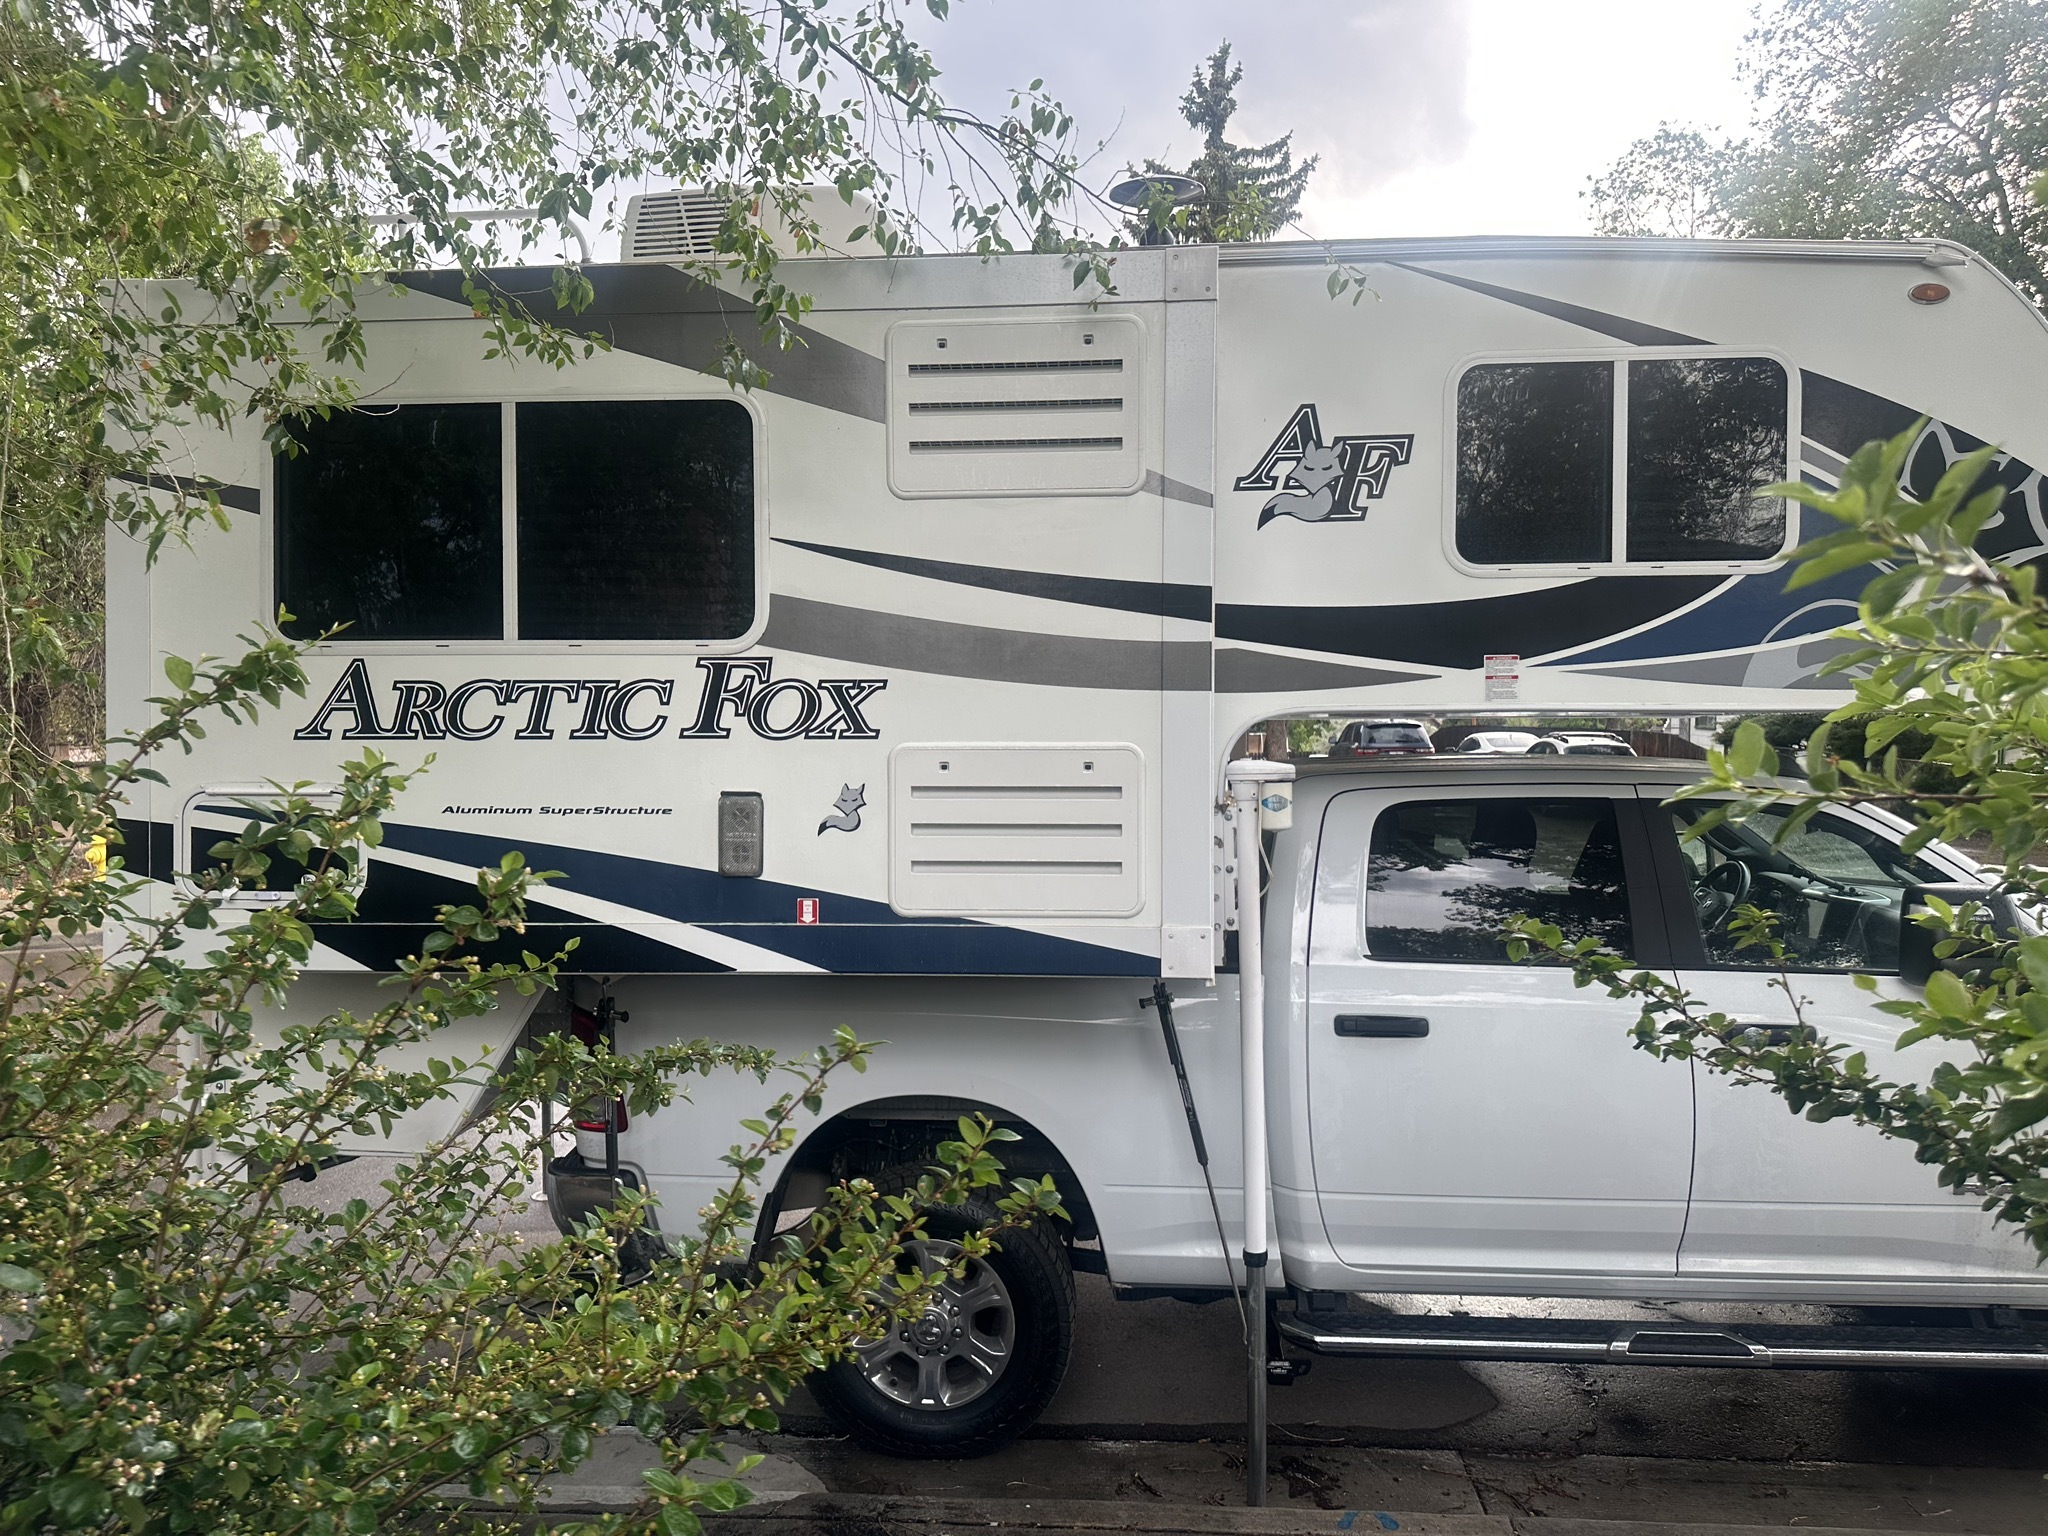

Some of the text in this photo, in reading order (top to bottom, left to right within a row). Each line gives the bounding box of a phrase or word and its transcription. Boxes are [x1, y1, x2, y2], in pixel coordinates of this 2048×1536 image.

[293, 656, 888, 741] ARCTIC FOX
[441, 805, 673, 817] Aluminum SuperStructure
